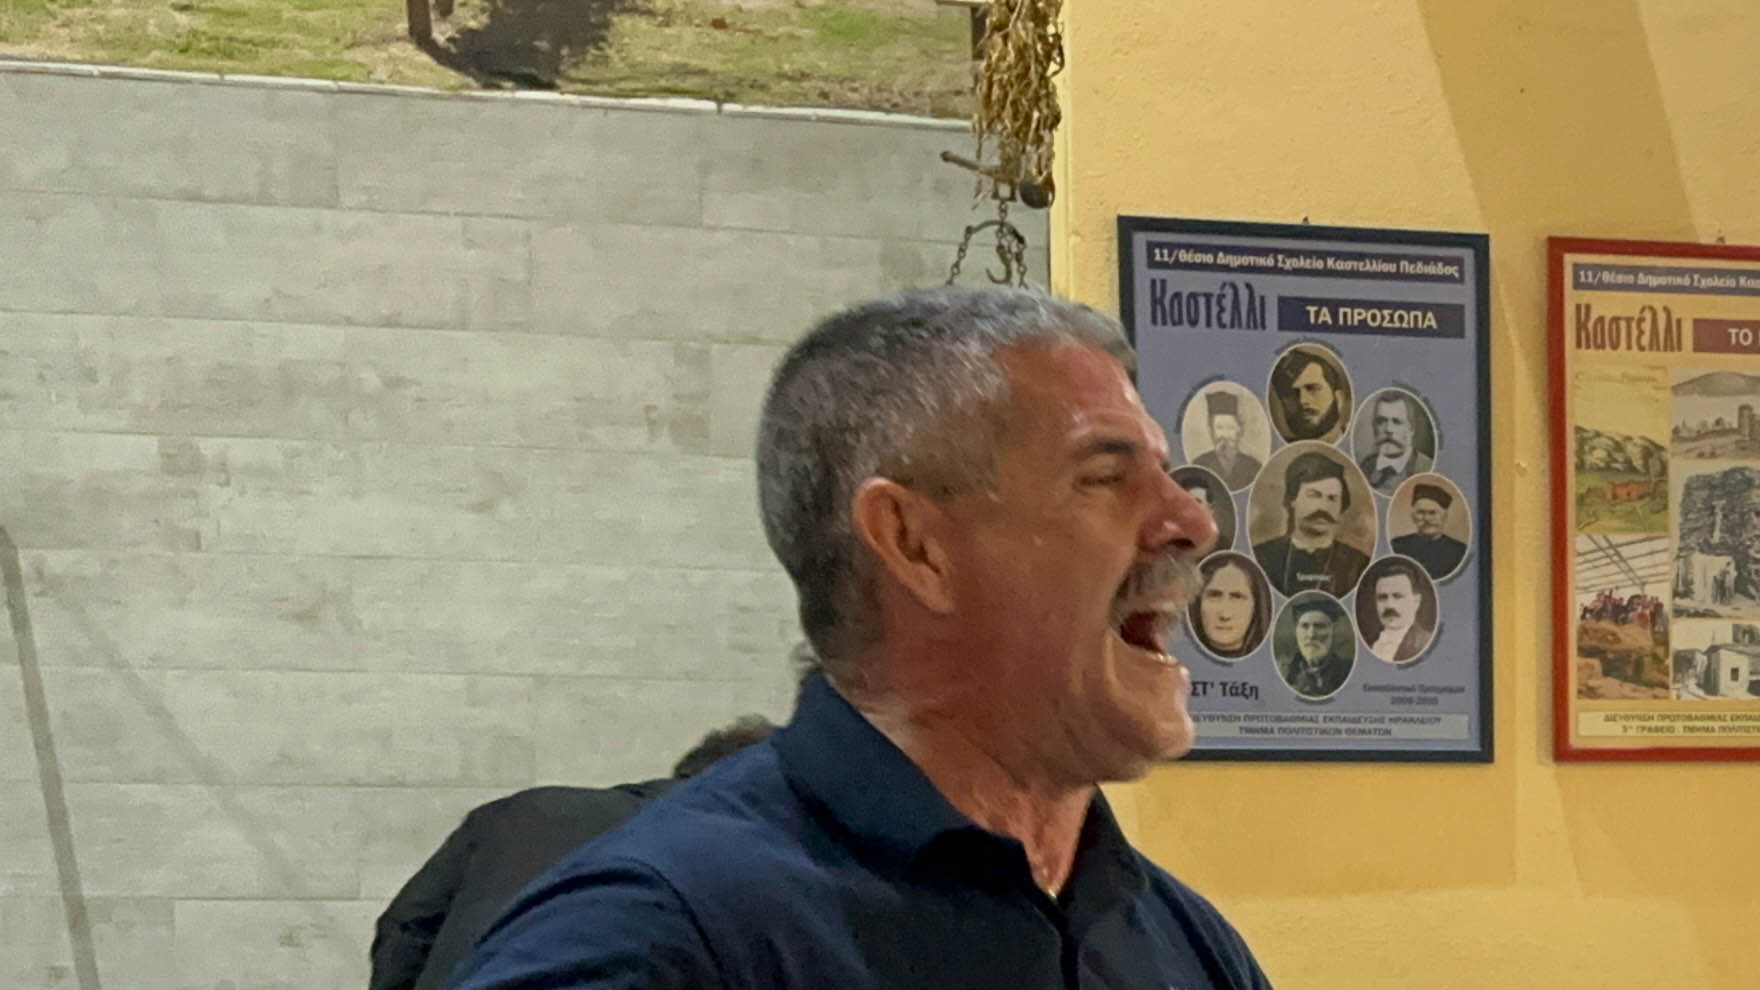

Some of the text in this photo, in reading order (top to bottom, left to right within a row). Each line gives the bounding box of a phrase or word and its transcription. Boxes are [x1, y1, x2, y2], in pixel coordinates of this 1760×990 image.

[1216, 250, 1274, 268] Δημοτικό
[1277, 252, 1325, 271] Σχολείο
[1326, 256, 1397, 273] Καστελλίου
[1150, 278, 1267, 331] Καστέλλι
[1305, 305, 1438, 330] ΤΑ ΠΡΟΣΩΠΑ
[1575, 303, 1683, 353] Καστέλλι
[1728, 328, 1753, 346] ΤΟ
